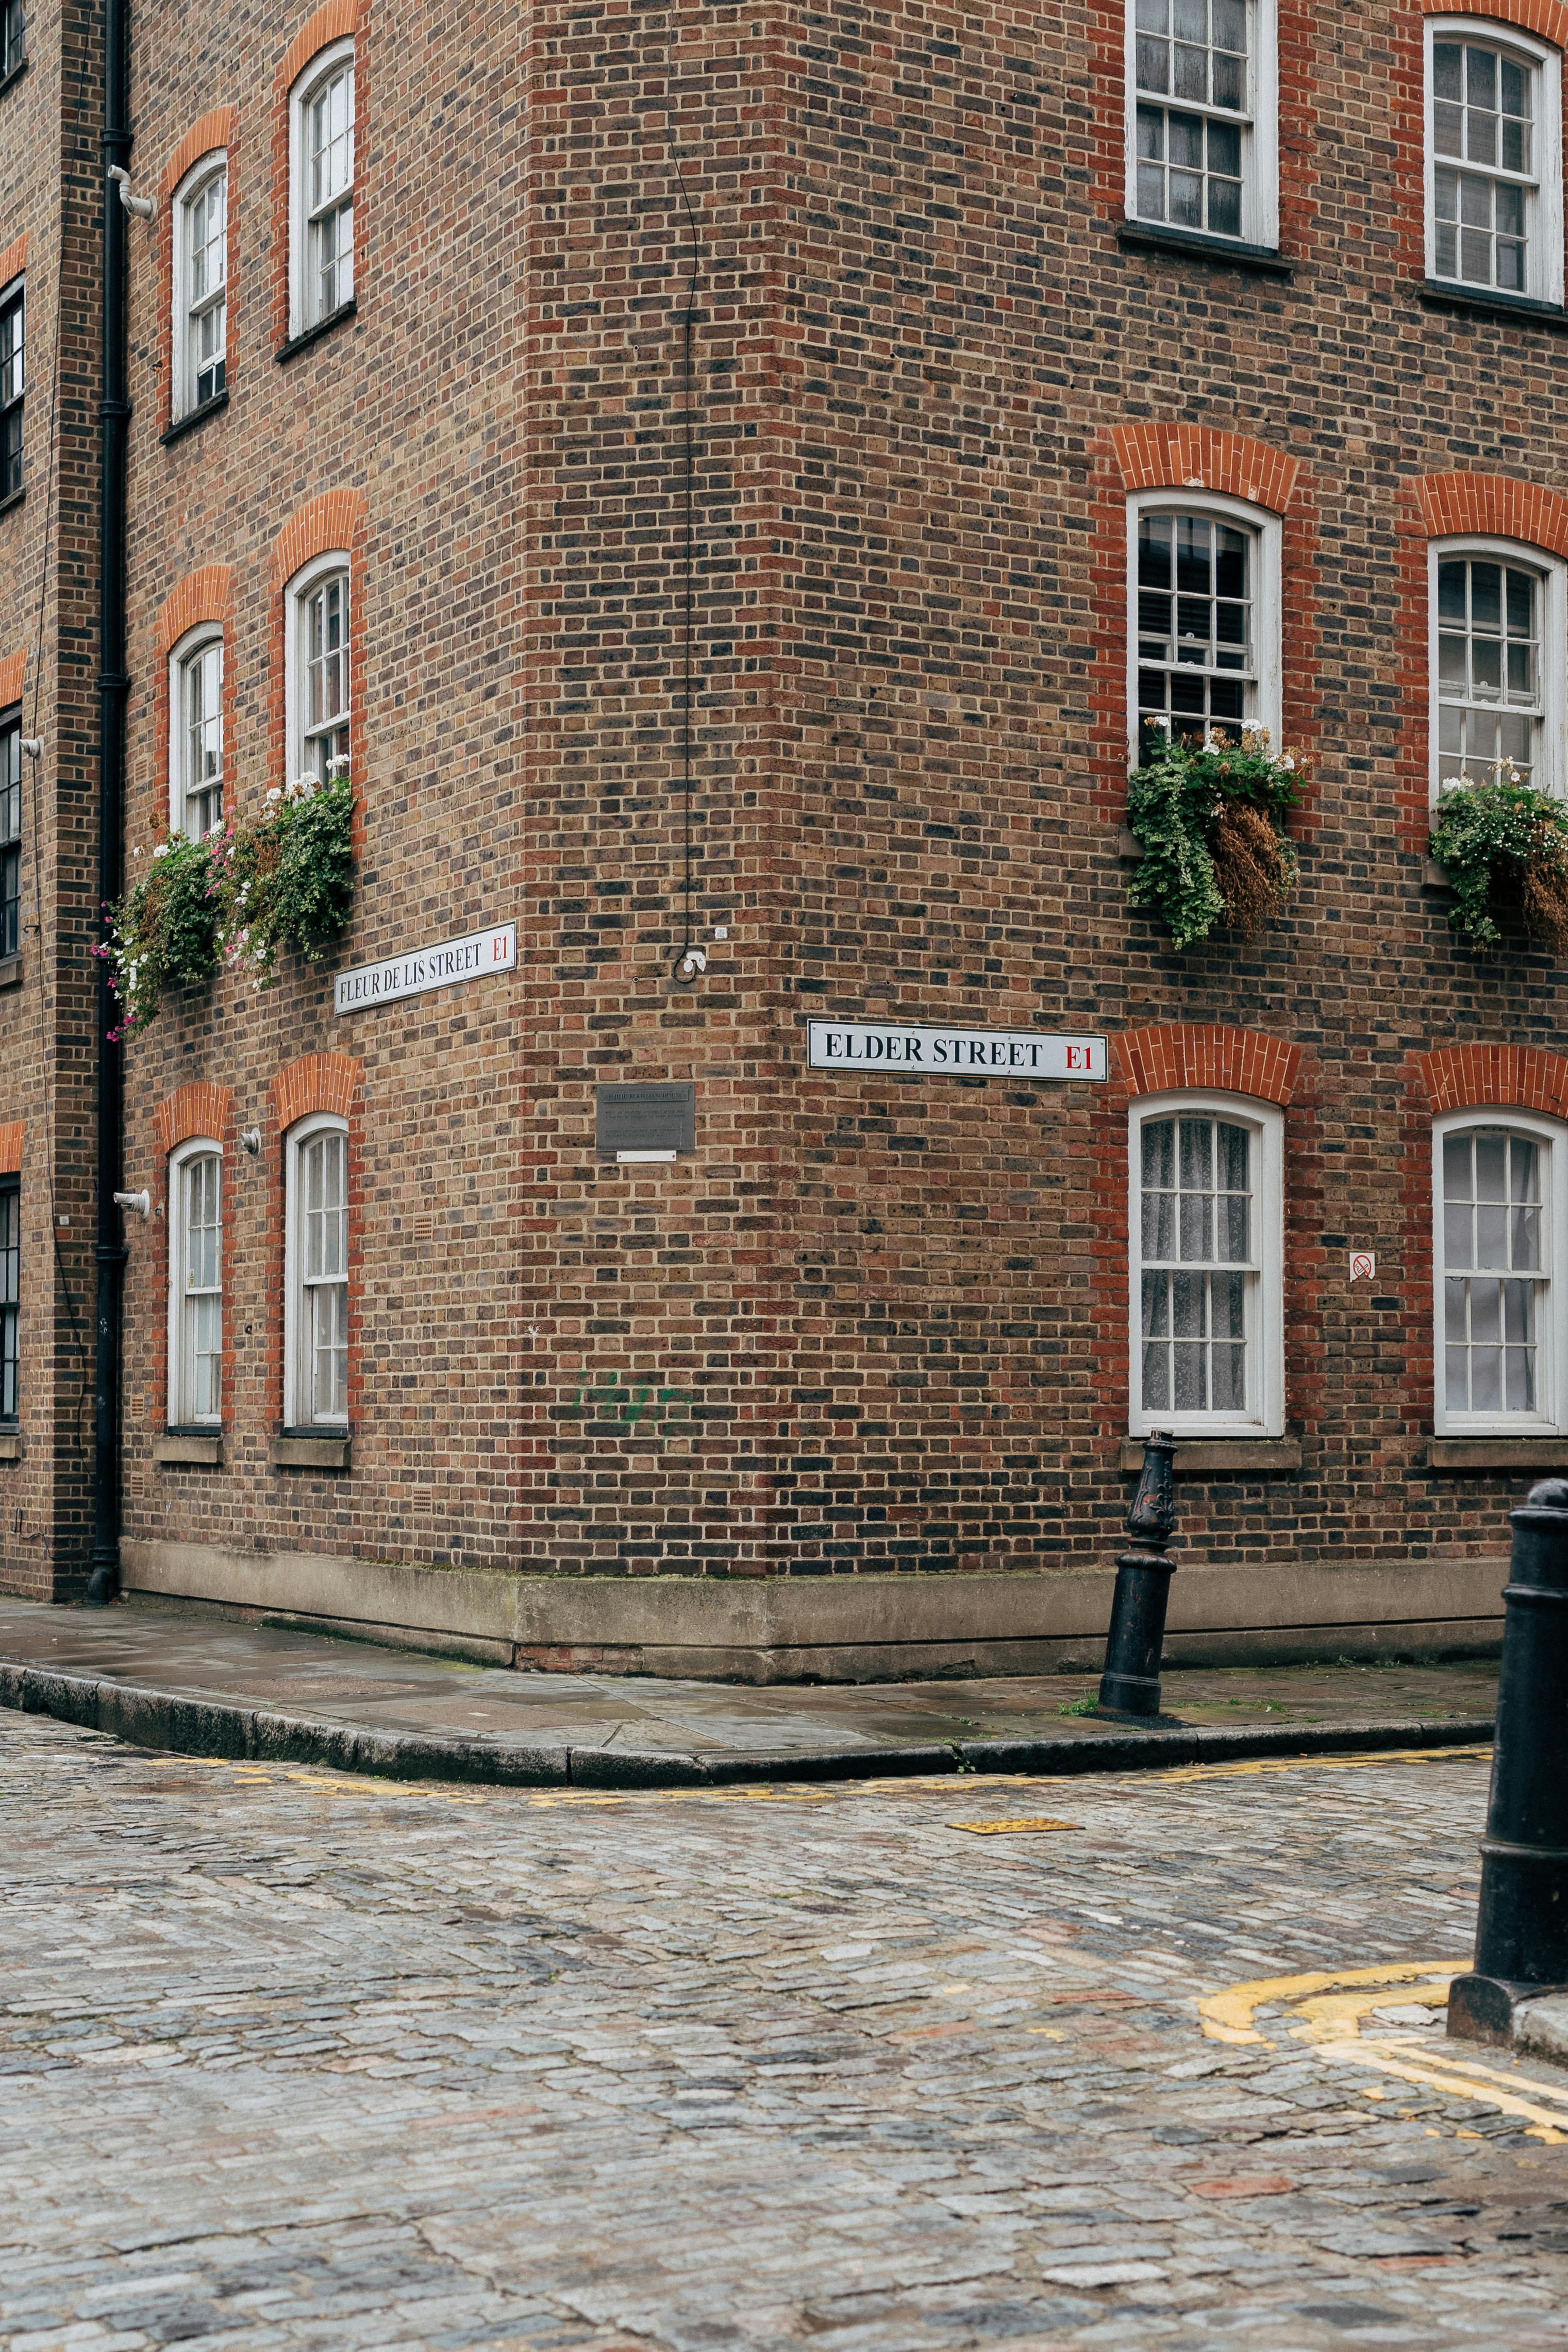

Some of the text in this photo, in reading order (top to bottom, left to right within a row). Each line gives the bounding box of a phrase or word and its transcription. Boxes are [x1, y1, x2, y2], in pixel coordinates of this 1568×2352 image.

[340, 936, 507, 1003] FLEUR DE LIS STREET E1
[824, 1033, 1093, 1070] ELDER STREET E1
